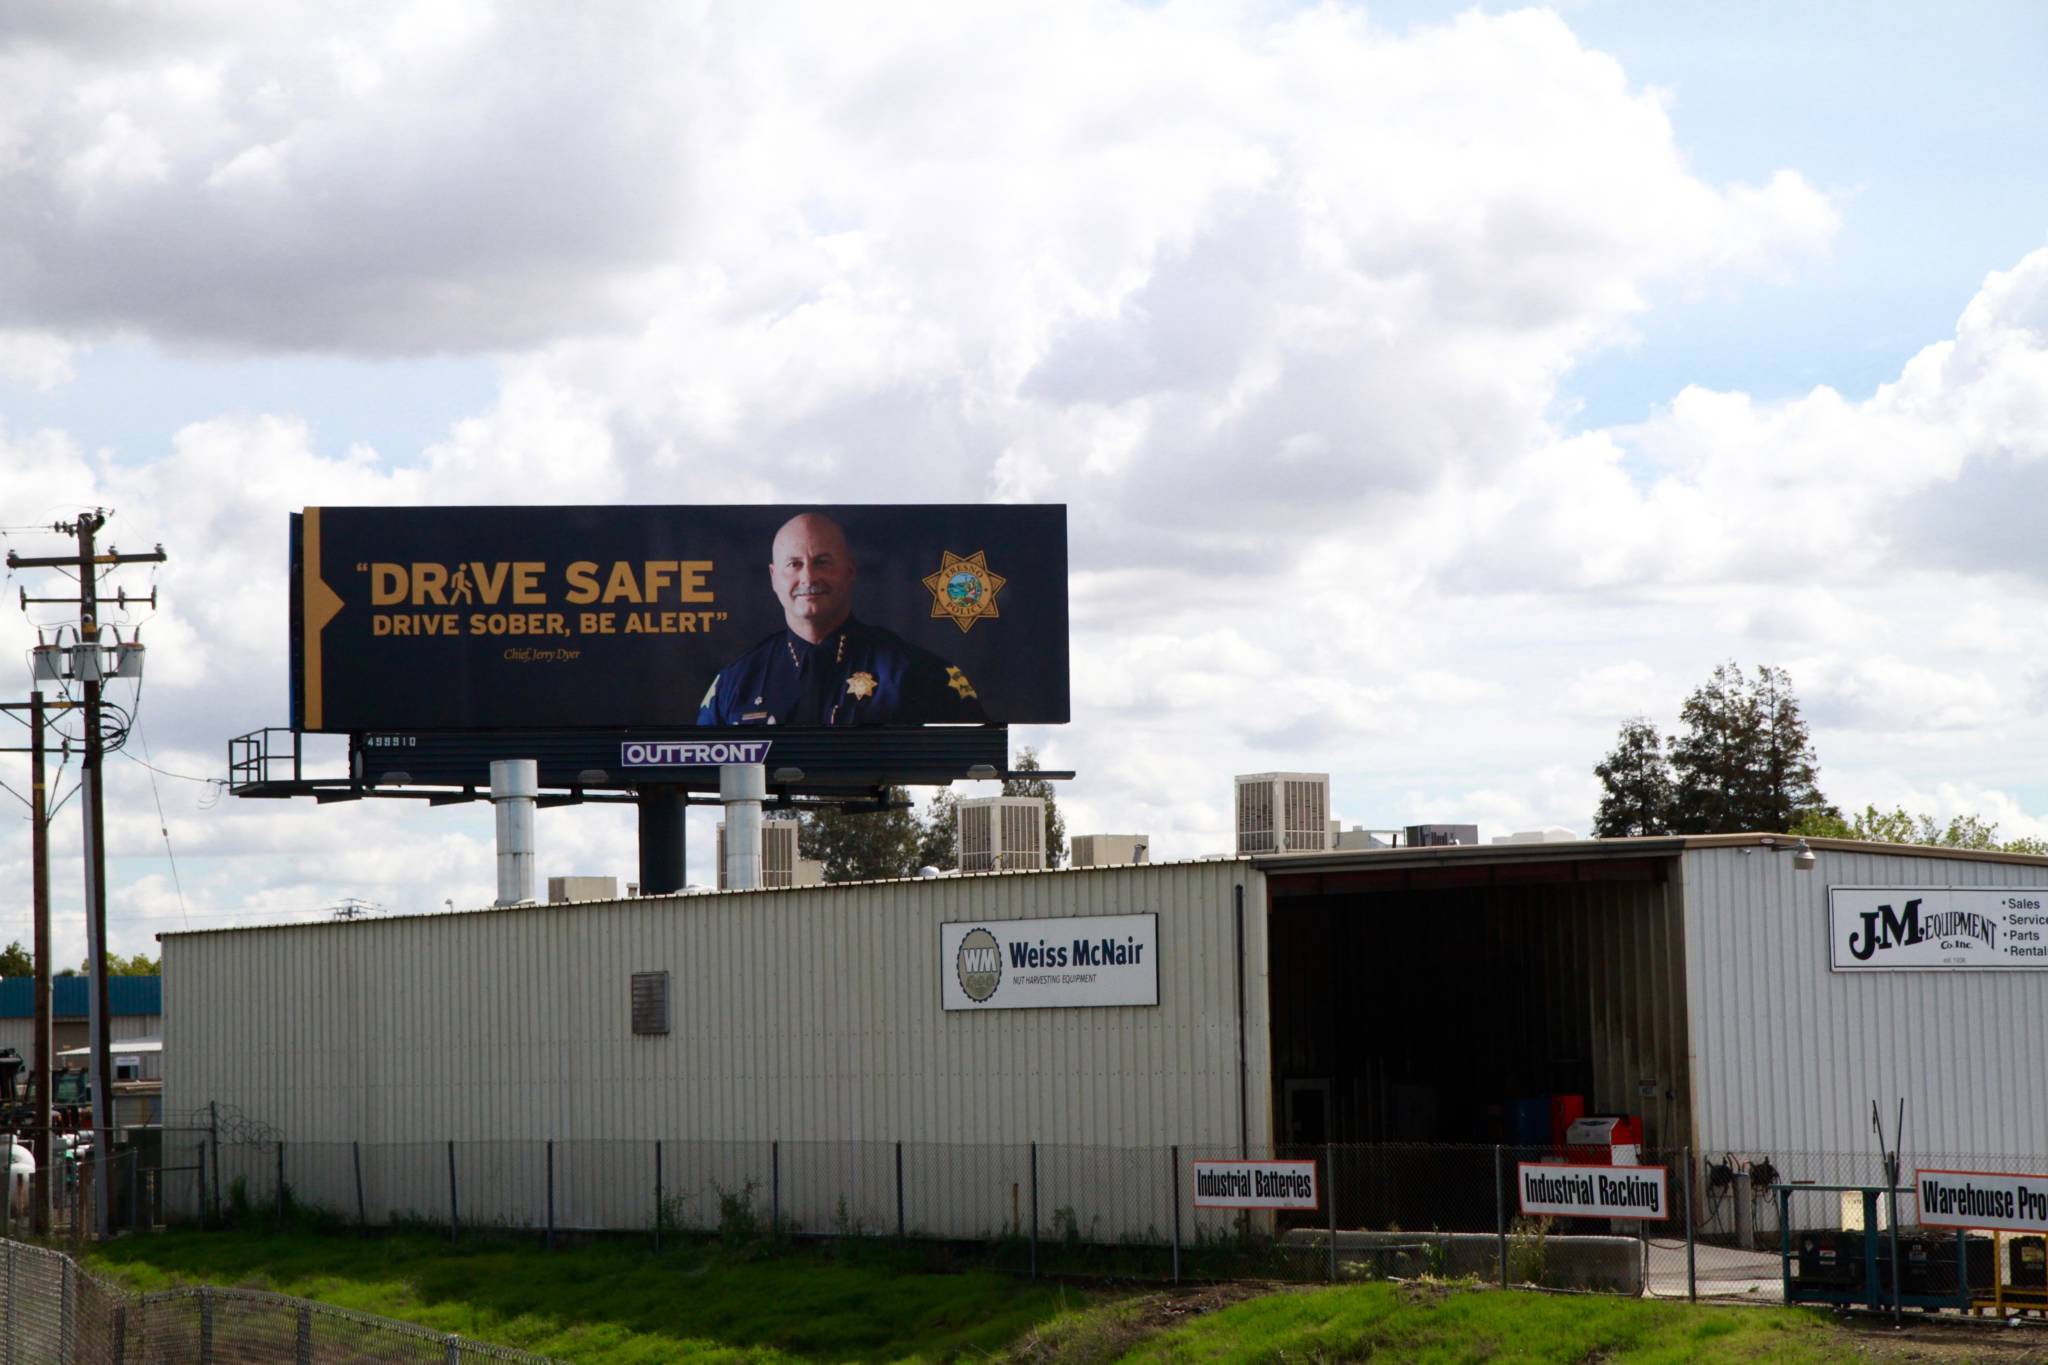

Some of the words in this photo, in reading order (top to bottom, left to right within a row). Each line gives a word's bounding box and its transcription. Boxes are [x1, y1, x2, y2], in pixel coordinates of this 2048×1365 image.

[565, 560, 714, 604] SAFE
[373, 614, 459, 636] DRIVE
[470, 613, 571, 637] SOBER,
[580, 613, 616, 634] BE
[627, 743, 763, 764] OUTFRONT
[2008, 897, 2041, 910] Sales
[1924, 911, 1997, 950] EQUIPMENT
[2010, 929, 2041, 941] Parts
[962, 948, 998, 974] WM
[1008, 938, 1067, 969] Weiss
[1072, 935, 1144, 967] McNair
[1012, 975, 1026, 985] NUT
[1025, 974, 1061, 985] HARVESTING
[1062, 973, 1097, 984] EQUIPMENT
[1197, 1169, 1252, 1197] Industrial
[1255, 1169, 1312, 1198] Batteries
[1525, 1172, 1595, 1206] Industrial
[1598, 1174, 1659, 1212] Racking
[1922, 1180, 2014, 1219] Warehouse
[2017, 1185, 2048, 1221] Pro
